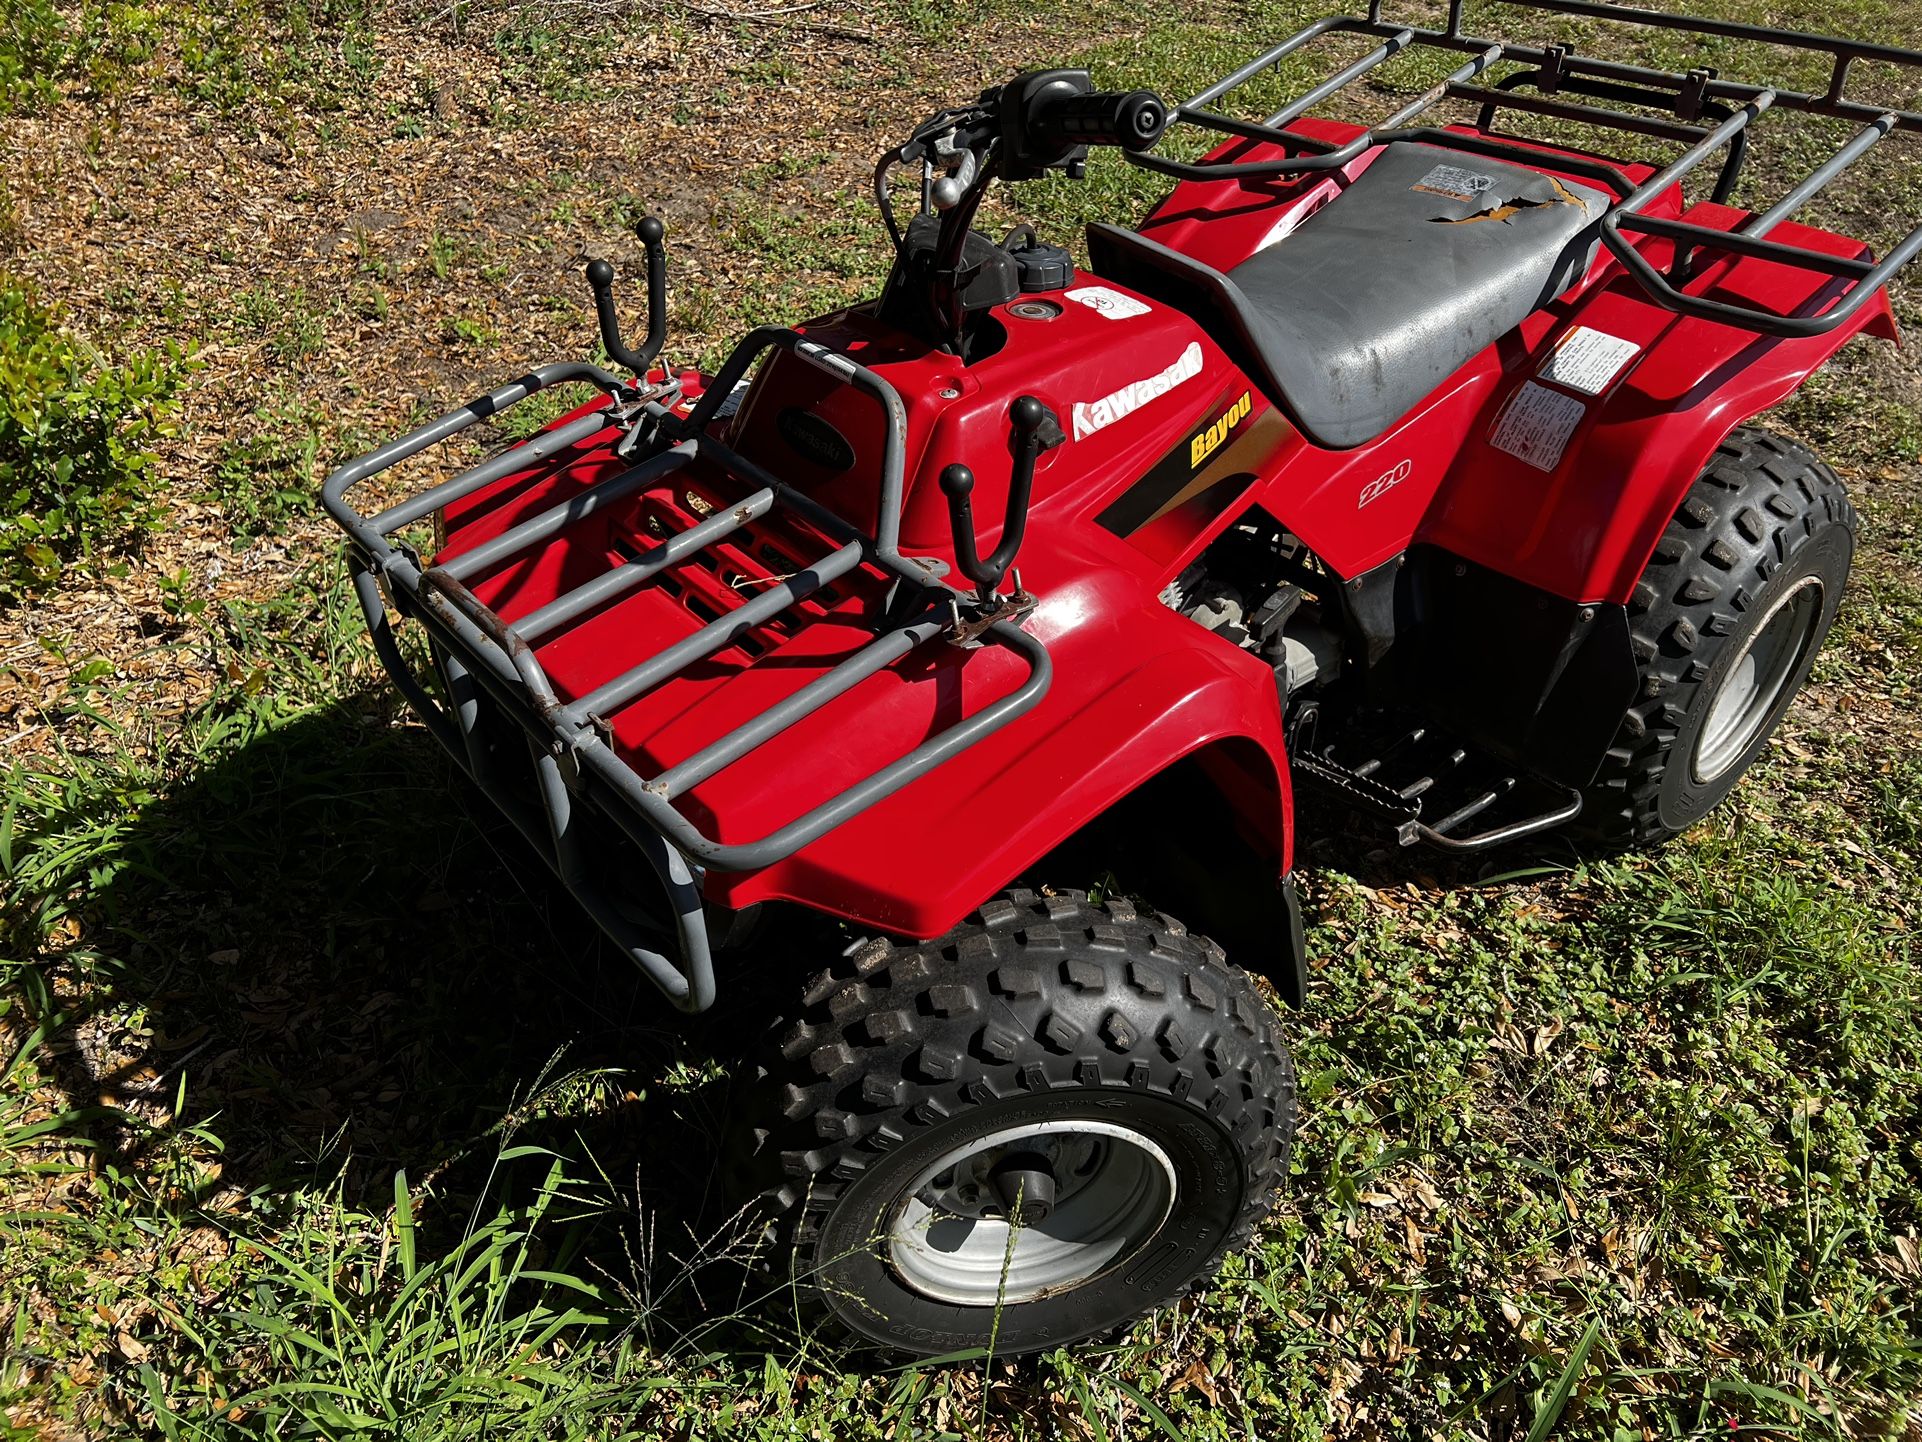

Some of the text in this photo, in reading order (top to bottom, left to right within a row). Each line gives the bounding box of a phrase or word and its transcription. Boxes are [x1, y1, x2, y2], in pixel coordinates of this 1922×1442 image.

[1072, 341, 1202, 441] Kawasak
[1190, 390, 1250, 469] Bayou
[1358, 459, 1411, 509] 220
